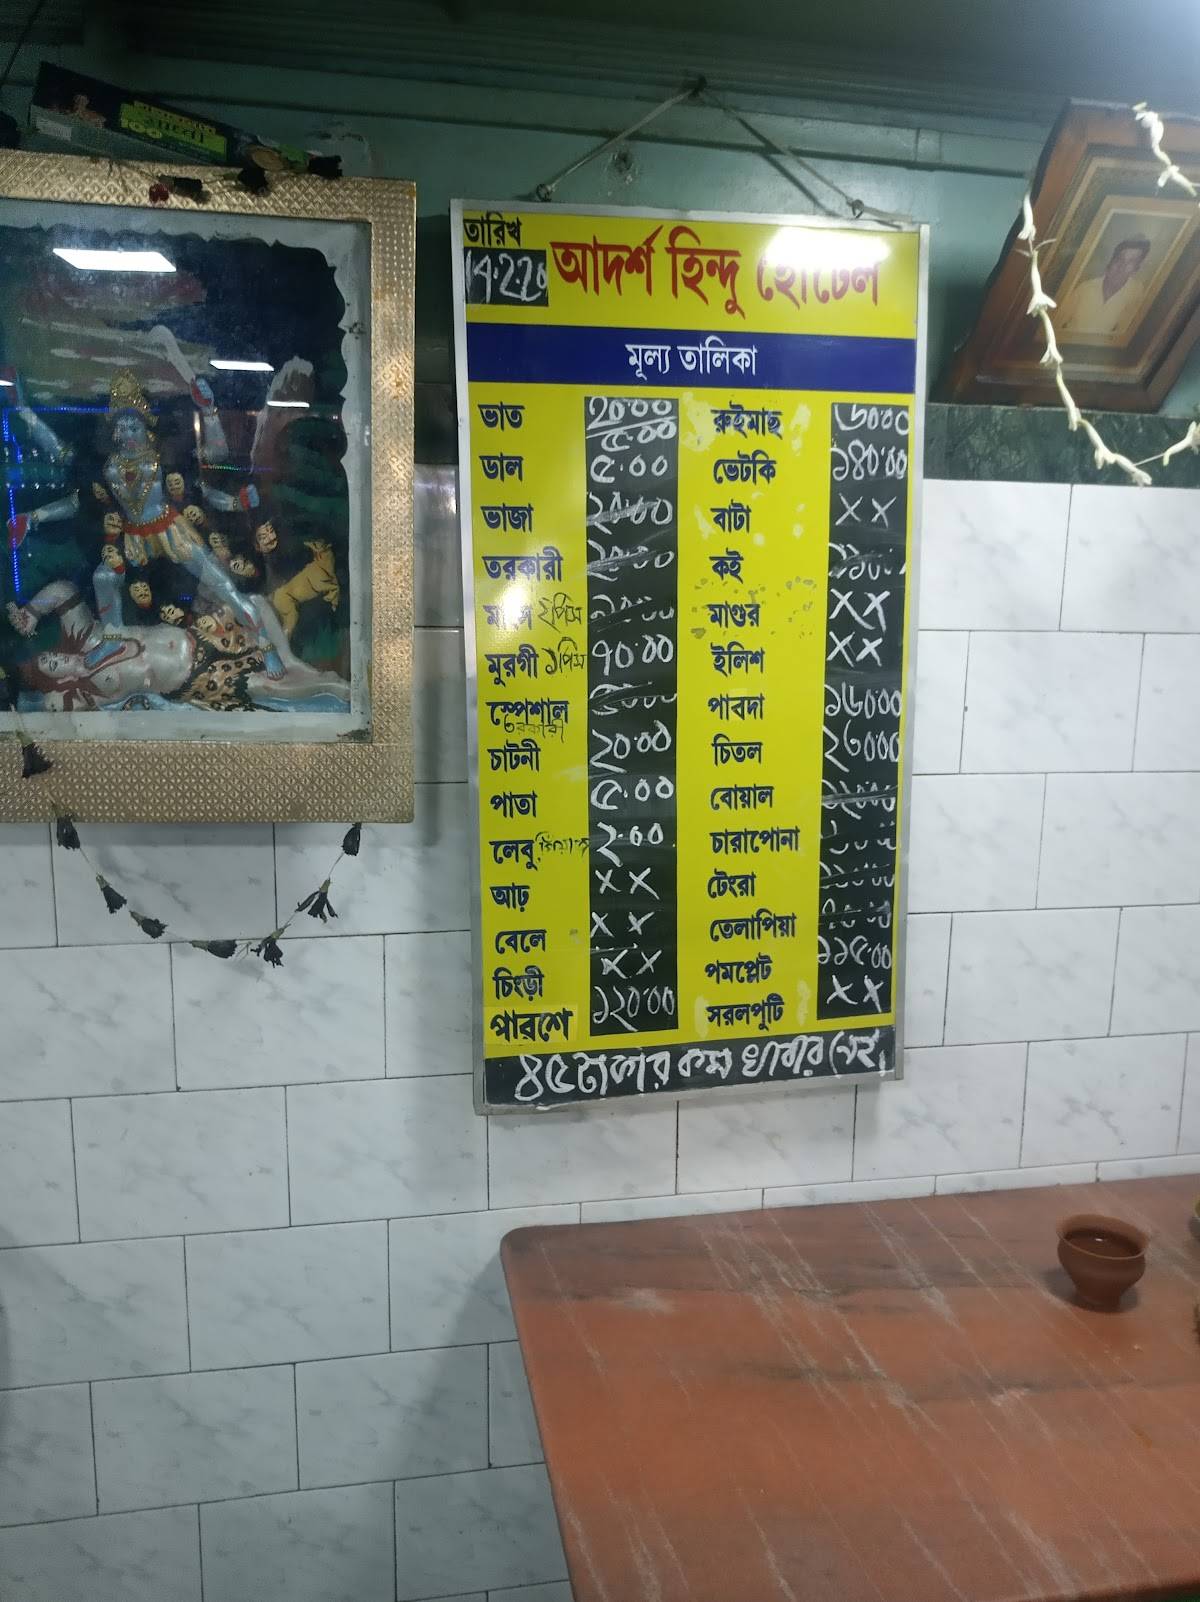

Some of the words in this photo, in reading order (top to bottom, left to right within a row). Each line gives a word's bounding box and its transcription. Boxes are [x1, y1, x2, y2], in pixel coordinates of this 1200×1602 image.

[463, 211, 522, 247] তারিখ
[551, 225, 664, 297] আদর্শ
[665, 225, 746, 319] হিন্দু
[625, 341, 671, 380] মূল্য
[677, 336, 757, 376] তালিকা
[478, 401, 525, 431] ভাত
[711, 400, 783, 440] রুইমাছ
[479, 452, 523, 482] ডাল
[713, 449, 777, 485] ভেটকি
[480, 503, 534, 532] ভাজা
[710, 498, 752, 533] বাটা
[482, 546, 563, 582] তরকারী
[709, 547, 744, 584] কই
[707, 601, 760, 629] মাগুর
[484, 643, 539, 686] মুরগী
[710, 641, 765, 677] ইলিশ
[486, 697, 569, 726] স্পেশাল
[707, 693, 765, 721] পাবদা
[487, 738, 541, 772] চাটনী
[711, 733, 763, 767] চিতল
[490, 791, 537, 818] পাতা
[710, 783, 774, 812] বোয়াল
[489, 838, 537, 870] লেবু
[709, 826, 800, 855] চারাপোনা
[707, 868, 757, 899] টেংরা
[495, 929, 547, 954] বেলে
[709, 908, 797, 942] তেলাপিয়া
[492, 965, 544, 1001] চিংড়ী
[704, 952, 773, 985] পমপ্লেট
[490, 1007, 573, 1042] পারশে
[706, 993, 785, 1031] সরলপুটি
